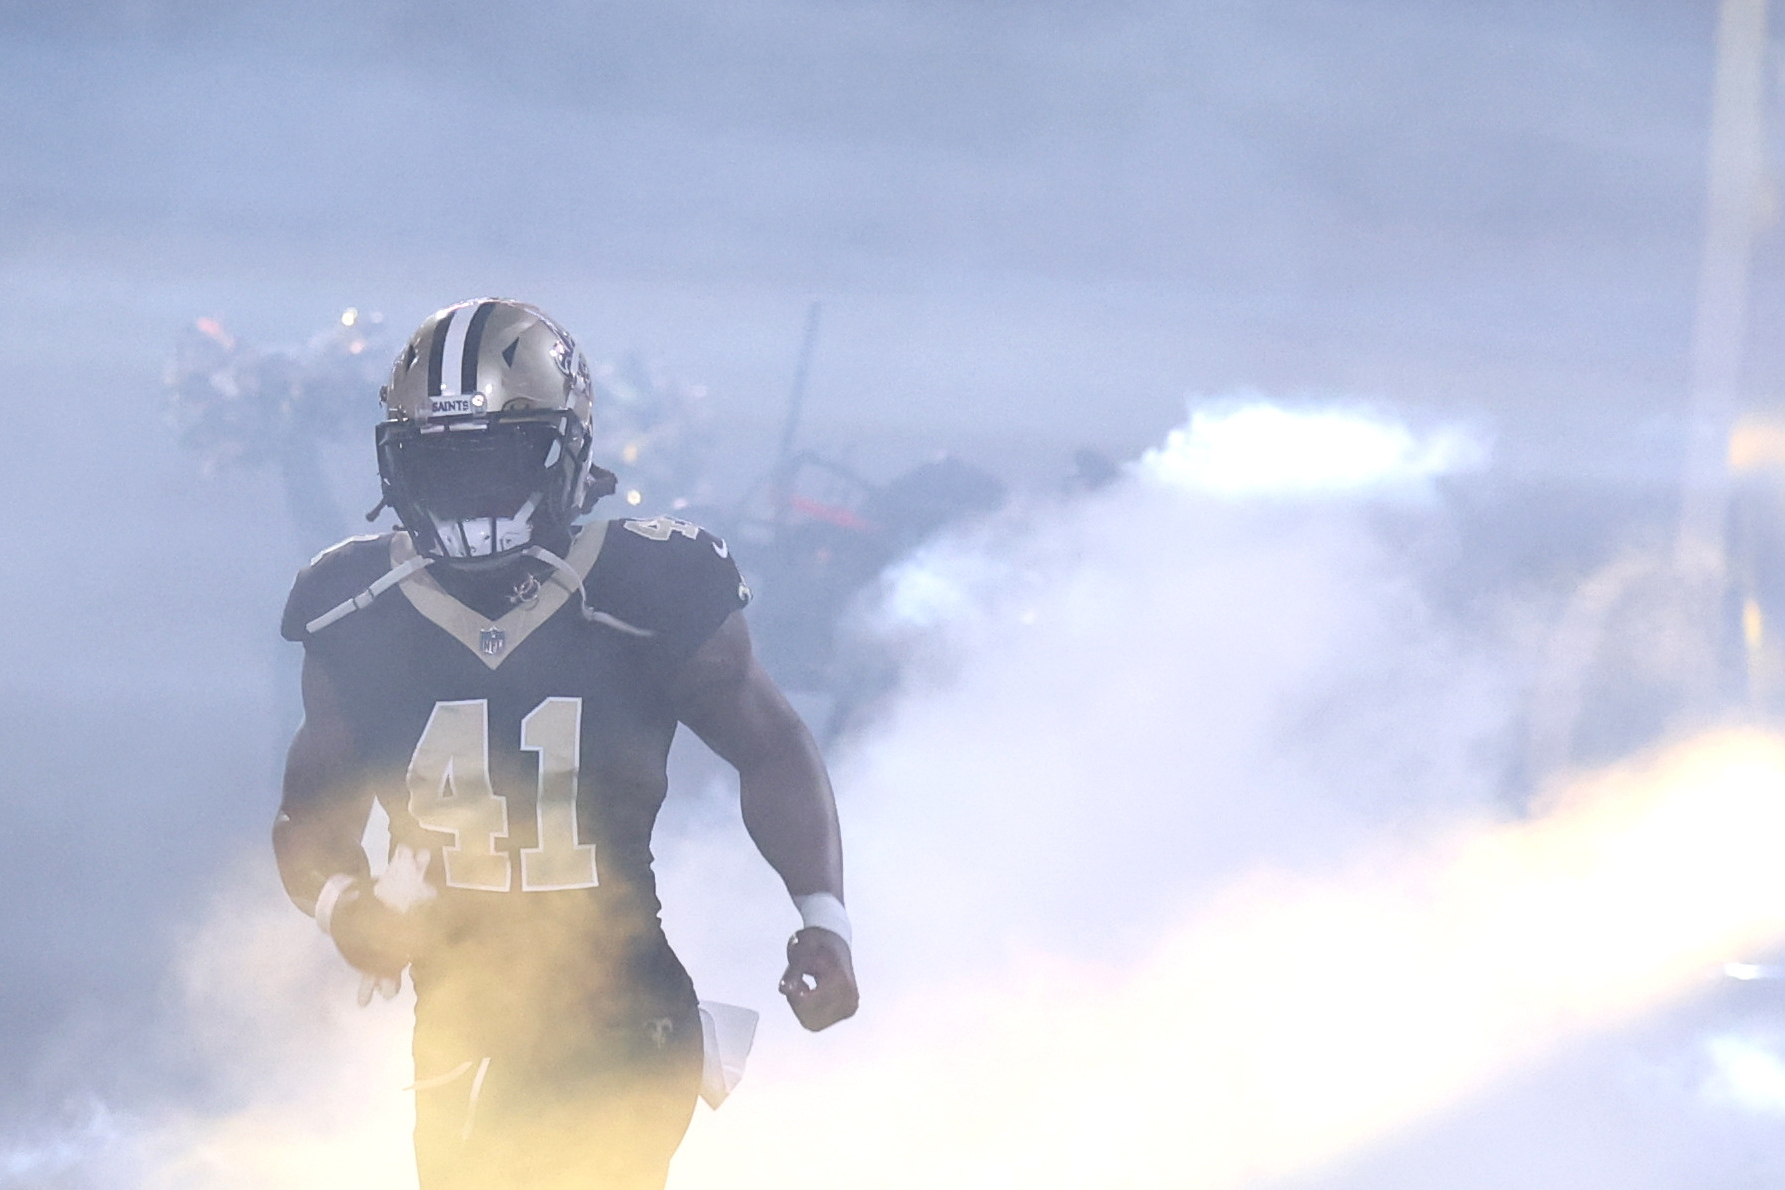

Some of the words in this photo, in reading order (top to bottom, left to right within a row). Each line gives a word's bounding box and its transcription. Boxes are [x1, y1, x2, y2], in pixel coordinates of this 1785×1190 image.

[432, 400, 469, 412] SAINTS
[623, 516, 704, 541] 4
[406, 697, 599, 892] 41
